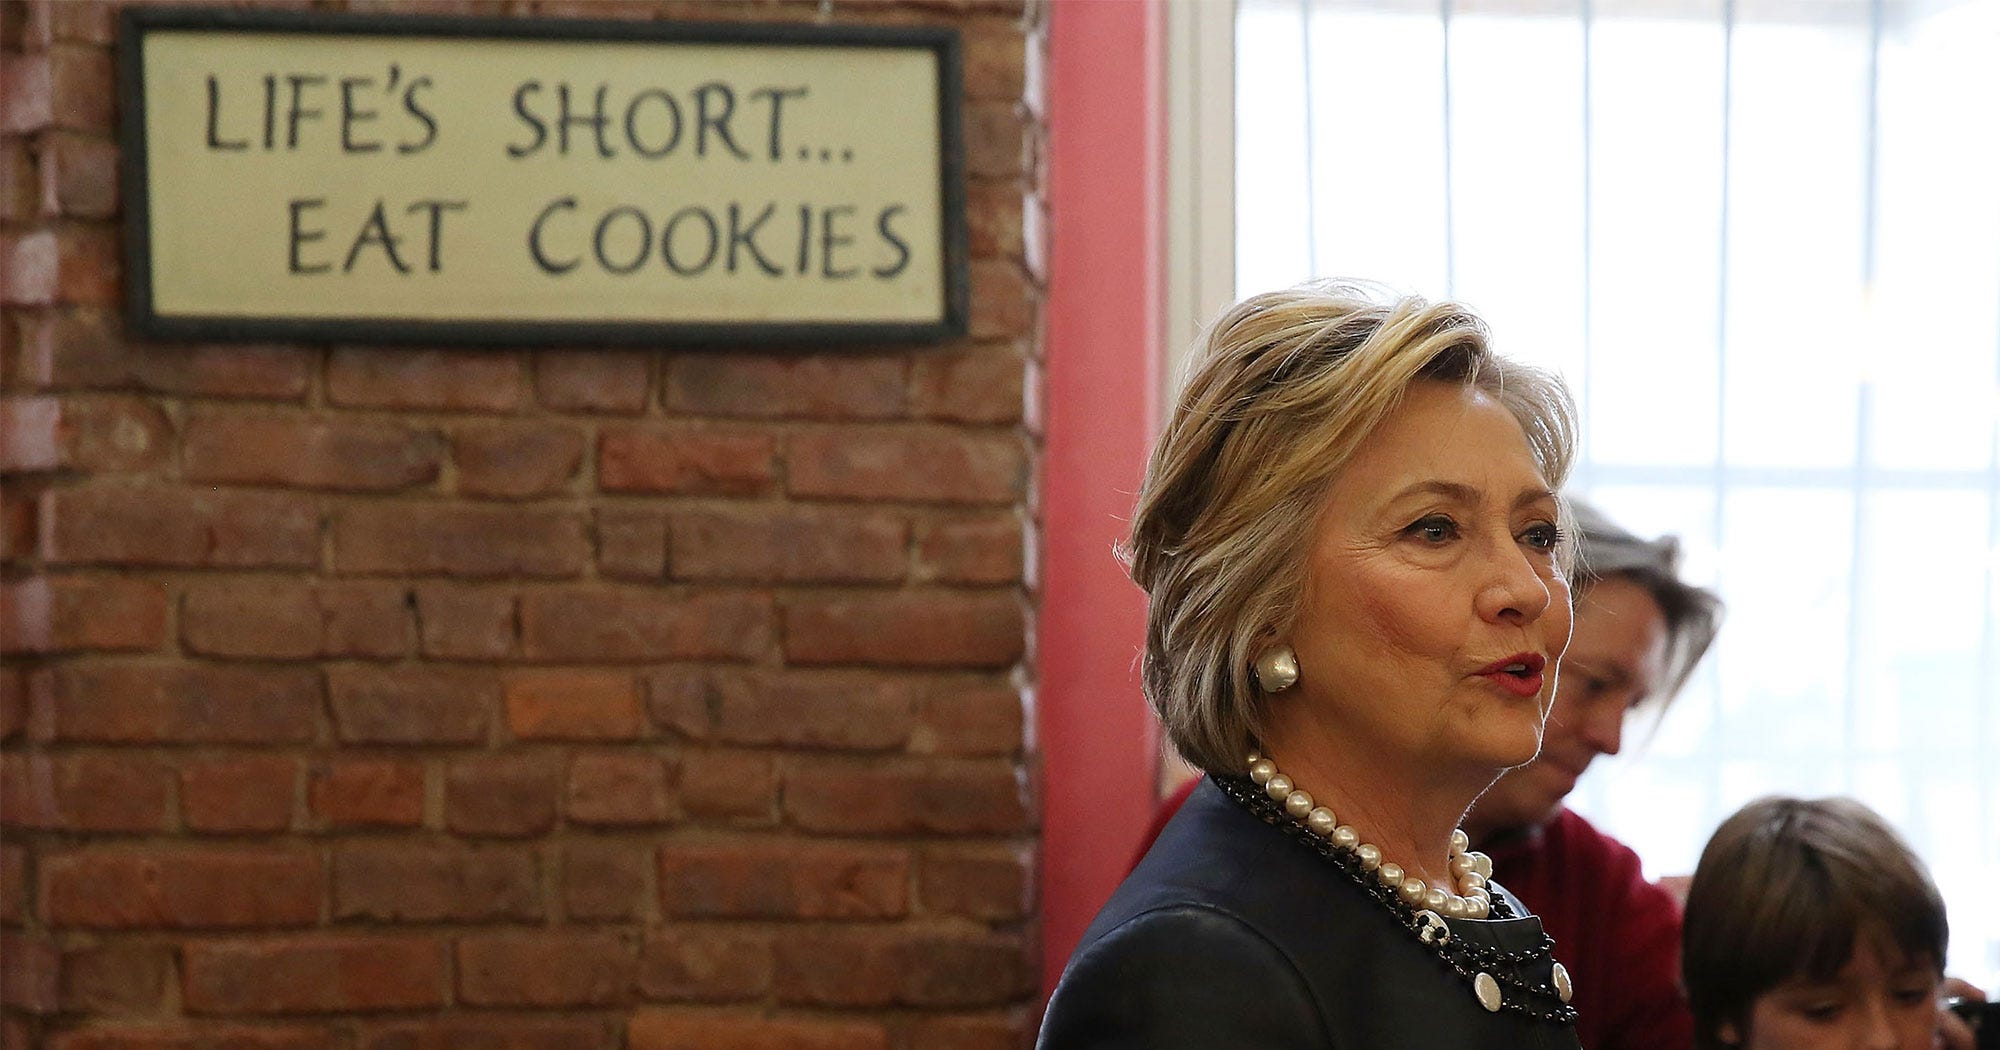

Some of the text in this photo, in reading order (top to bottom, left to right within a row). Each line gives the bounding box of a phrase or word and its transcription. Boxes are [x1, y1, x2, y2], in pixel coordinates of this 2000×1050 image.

[205, 64, 854, 163] LIFE'S SHORT...
[287, 197, 912, 281] EAT COOKIES
